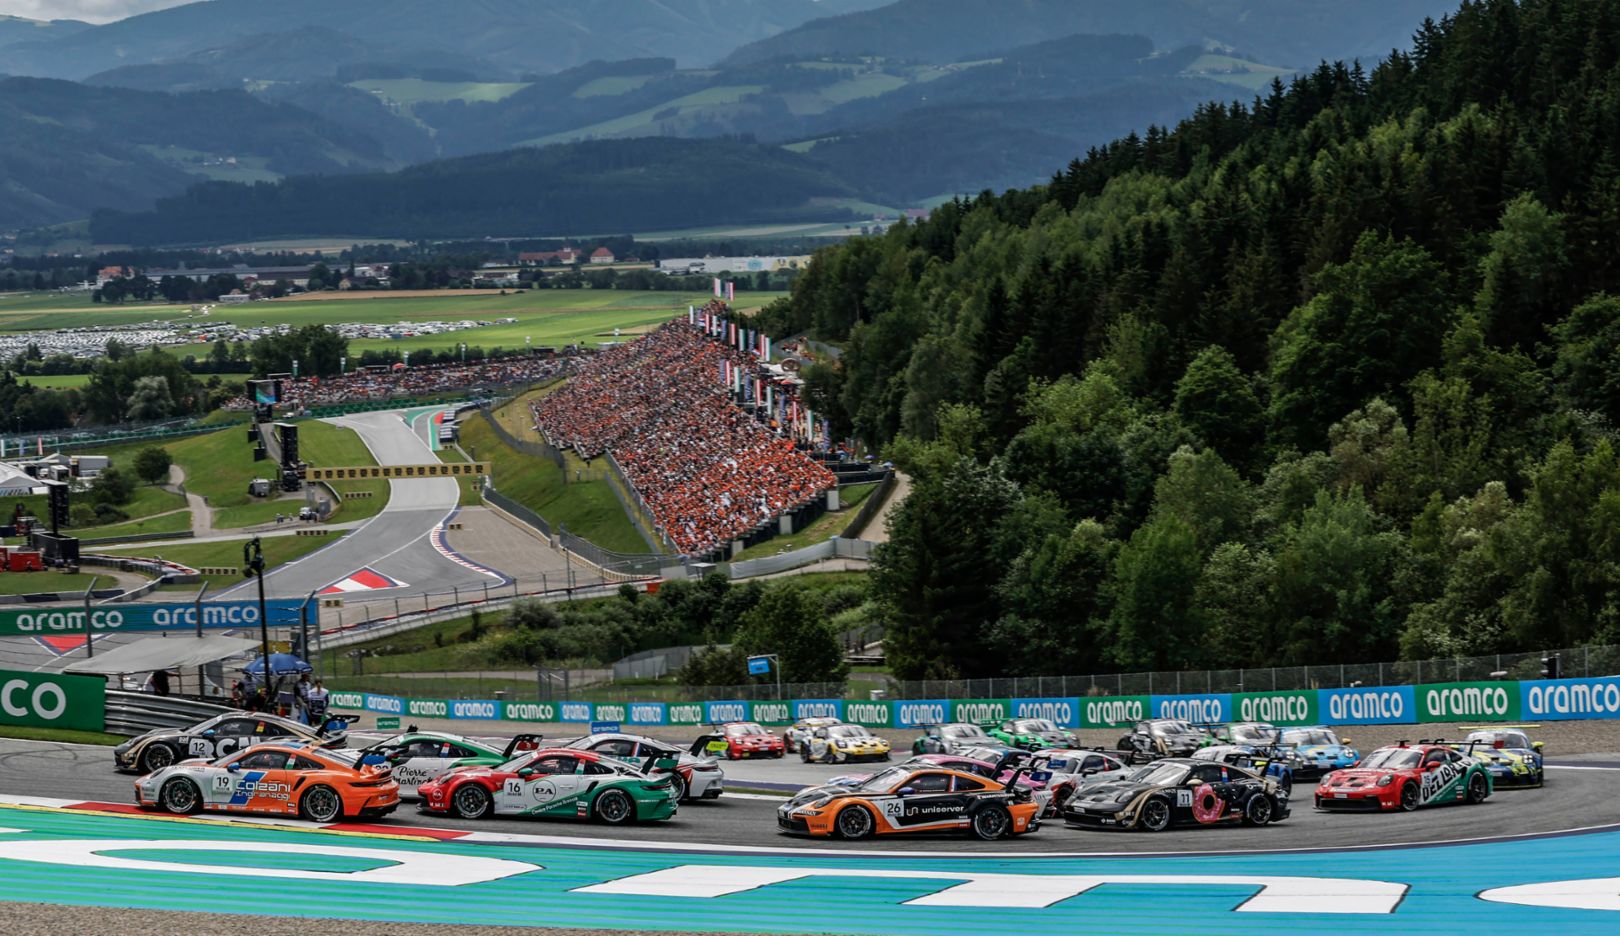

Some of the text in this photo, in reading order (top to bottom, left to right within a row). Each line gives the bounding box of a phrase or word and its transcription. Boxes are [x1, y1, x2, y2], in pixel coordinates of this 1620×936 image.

[16, 610, 124, 632] aramco
[153, 606, 259, 626] aramco
[329, 693, 363, 707] ramco
[367, 696, 401, 712] aramco
[1330, 692, 1404, 720] aramco
[1427, 687, 1509, 716] aramco
[1529, 683, 1620, 714] aramco
[409, 700, 447, 716] aramco
[454, 702, 494, 717] aramco
[506, 703, 553, 720] aramco
[562, 704, 590, 720] aramco
[597, 706, 625, 722] aramco
[632, 705, 662, 722] aramco
[670, 705, 702, 722] aramco
[709, 704, 745, 721] aramco
[753, 705, 789, 723] aramco
[797, 703, 837, 720] aramco
[847, 704, 888, 724] aramco
[900, 704, 944, 724] aramco
[956, 703, 1004, 725] aramco
[1018, 702, 1071, 724] aramco
[1087, 700, 1142, 724] aramco
[1161, 699, 1222, 723] aramco
[1241, 696, 1308, 722] aramco
[193, 742, 205, 752] 12
[398, 766, 427, 777] Pierre
[216, 776, 229, 787] 19
[235, 780, 291, 792] Colzani
[508, 782, 521, 793] 16
[235, 790, 291, 801] Ingranaggi
[887, 803, 900, 813] 26
[922, 806, 965, 814] uniserver
